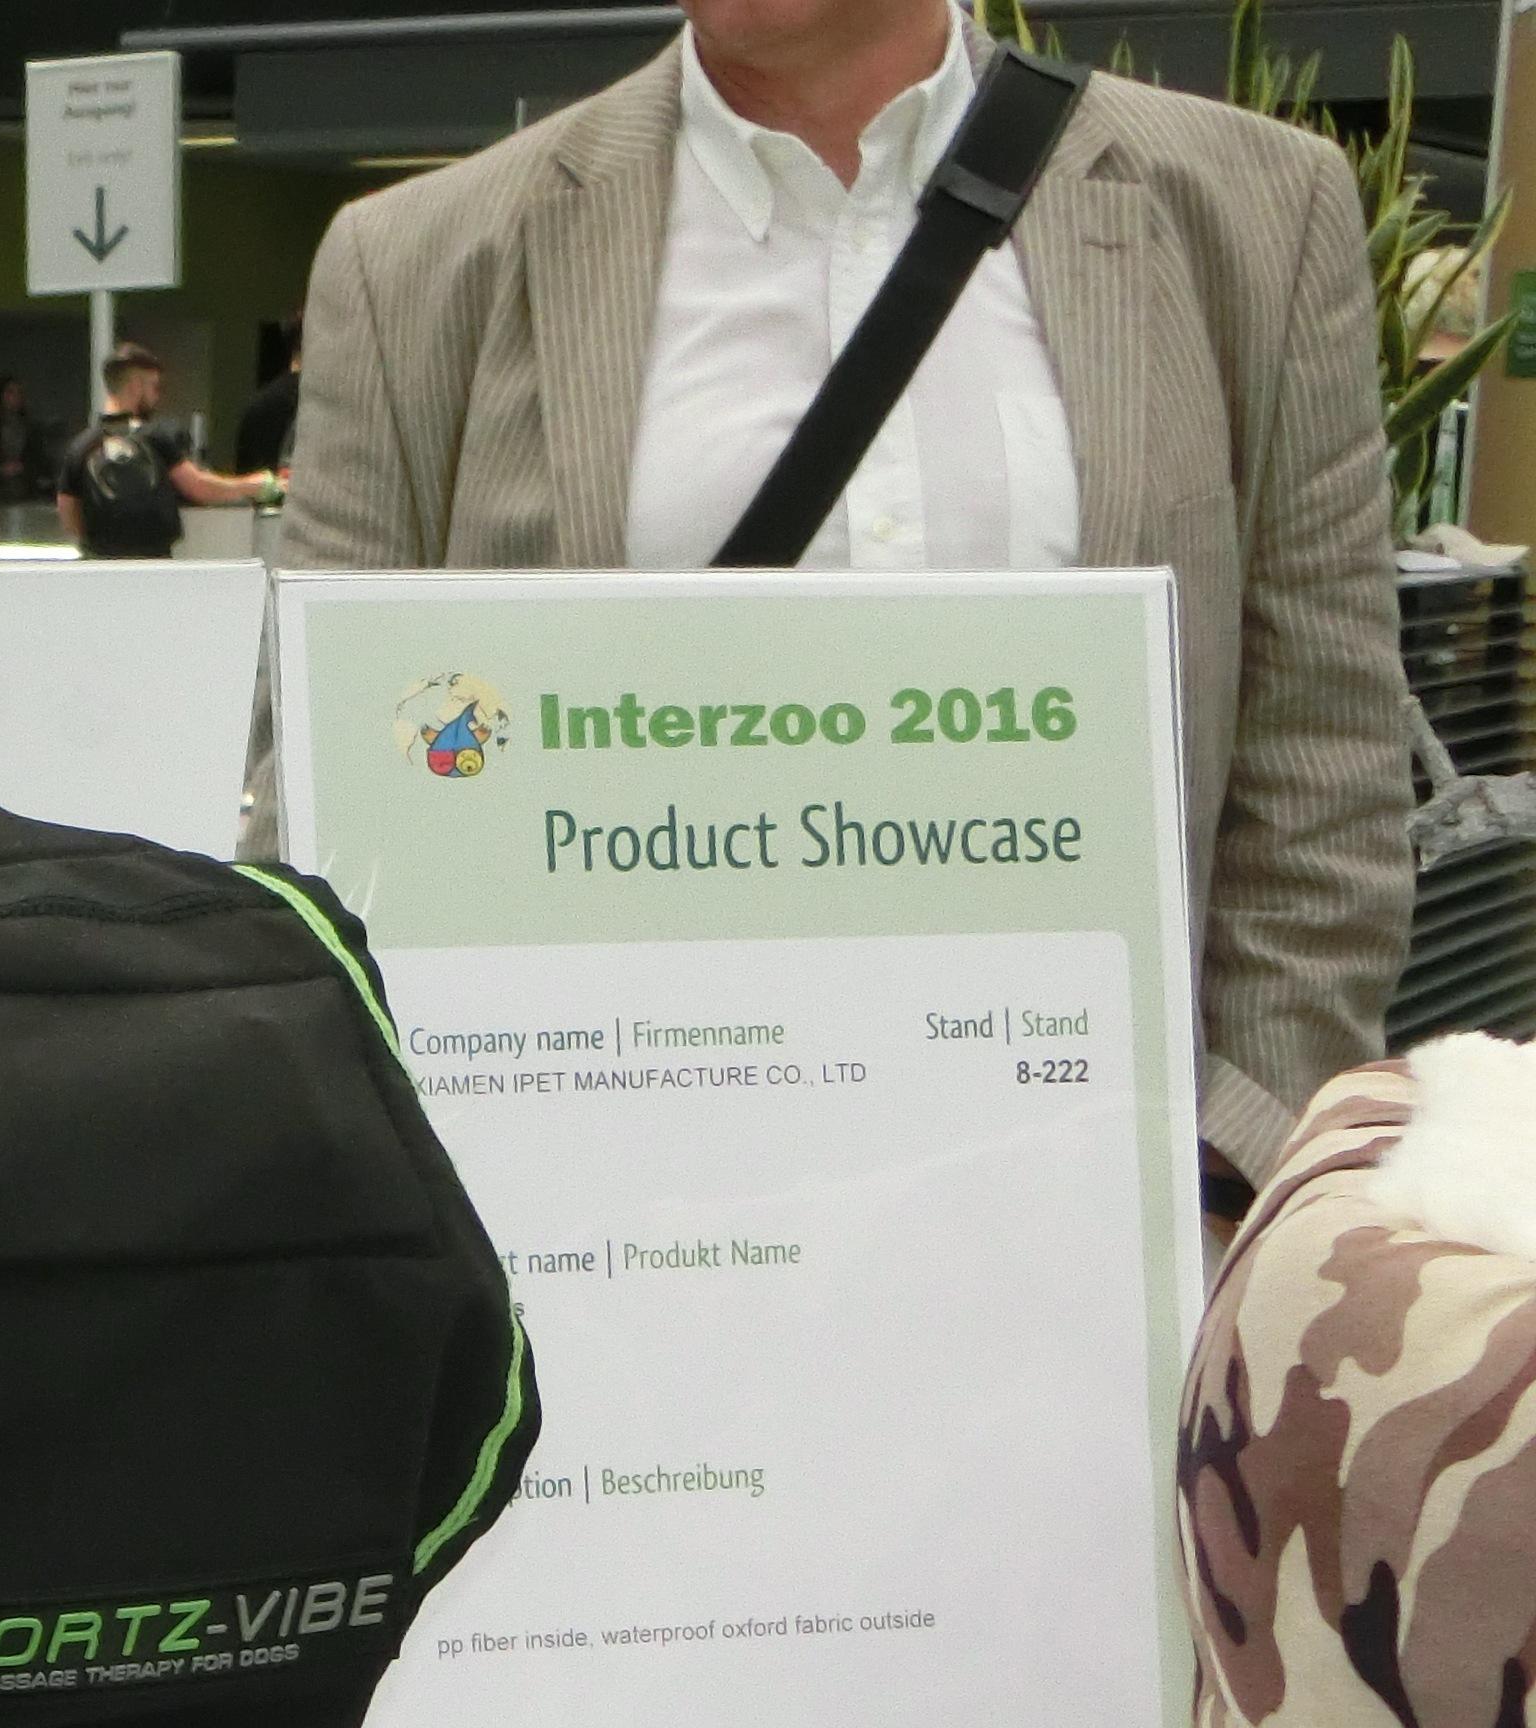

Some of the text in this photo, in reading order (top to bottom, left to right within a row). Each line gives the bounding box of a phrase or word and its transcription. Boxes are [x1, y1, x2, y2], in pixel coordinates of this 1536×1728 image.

[539, 686, 1077, 750] Interzoo 2016
[544, 800, 1082, 873] Product Showcase
[409, 1020, 785, 1062] Company name Firmenname
[925, 1008, 1089, 1040] Stand Stand
[417, 1073, 504, 1096] XIAMEN
[513, 1071, 566, 1094] IPET
[574, 1065, 758, 1091] MANUFACTURE
[822, 1062, 867, 1084] LTD
[1016, 1058, 1089, 1085] 8-222
[528, 1251, 596, 1274] name
[623, 1239, 721, 1270] Produkt
[731, 1239, 801, 1266] Name
[601, 1462, 765, 1498] Beschreibung
[437, 1609, 935, 1660] pp fiber inside, waterproof oxford fabric outside
[85, 1656, 185, 1685] THERAPY
[191, 1651, 234, 1673] FOR
[238, 1643, 301, 1668] DOGS
